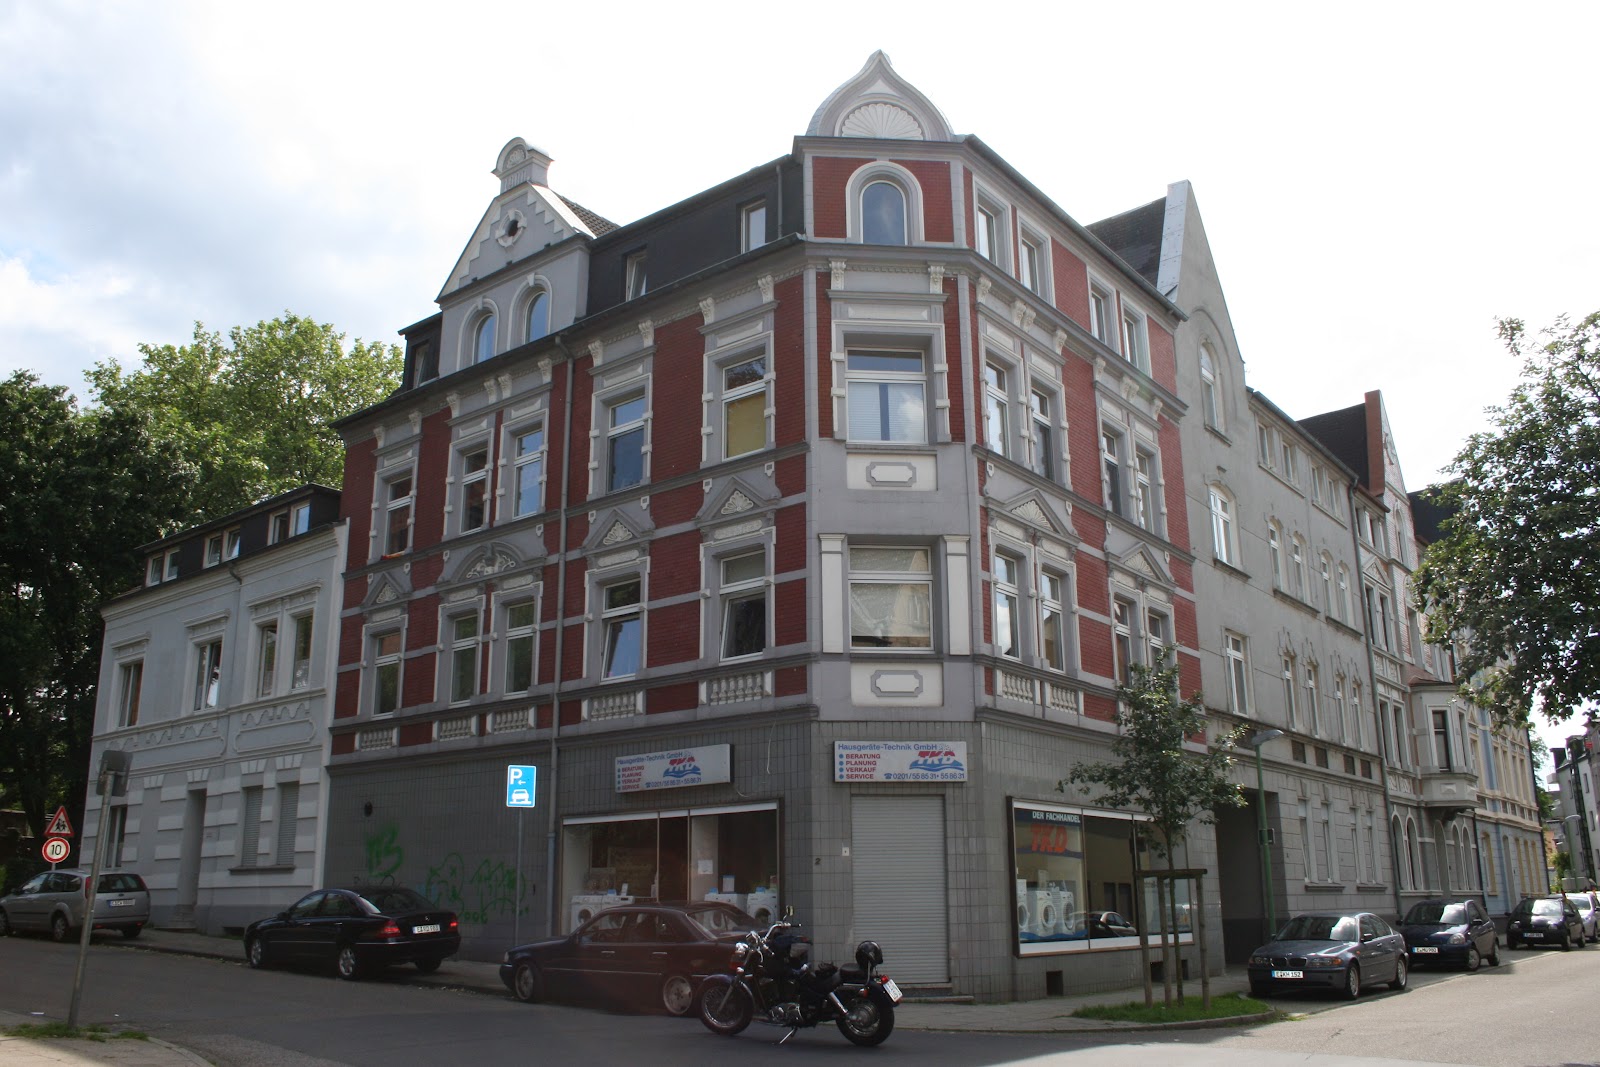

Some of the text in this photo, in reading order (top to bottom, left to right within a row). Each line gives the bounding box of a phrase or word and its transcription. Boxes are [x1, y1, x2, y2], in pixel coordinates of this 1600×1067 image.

[838, 744, 912, 752] Hausgeräte-Technik
[617, 754, 665, 765] Hausgeräte-Technik
[510, 768, 522, 785] P
[1033, 811, 1080, 822] DER FACHHANDEL
[1031, 824, 1068, 853] TKD
[51, 844, 61, 856] 10
